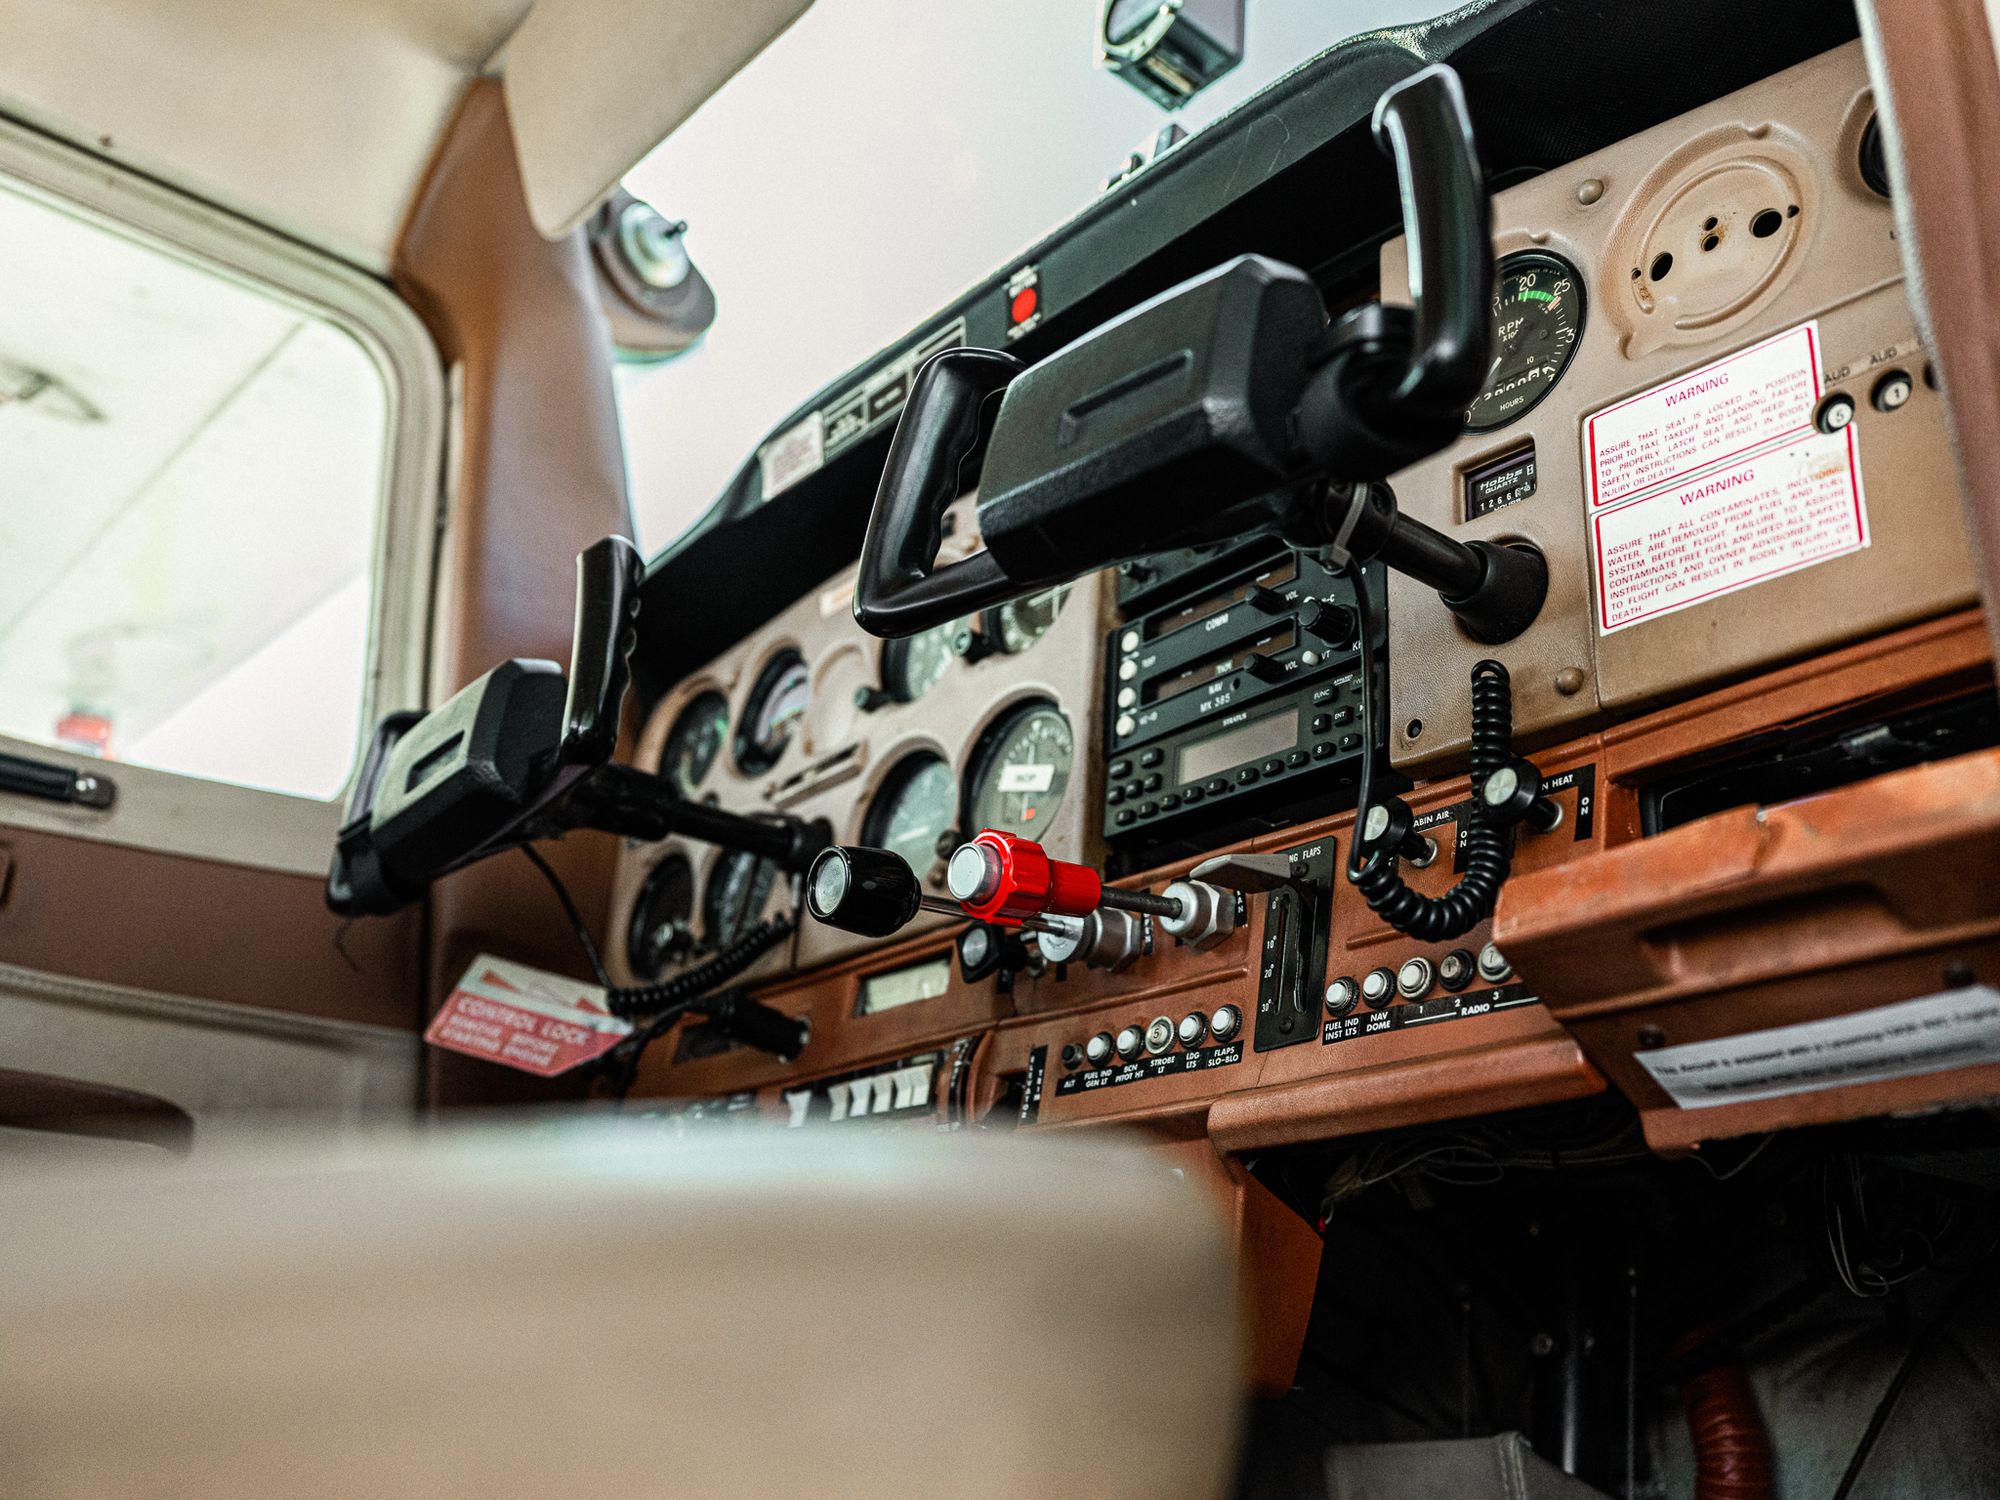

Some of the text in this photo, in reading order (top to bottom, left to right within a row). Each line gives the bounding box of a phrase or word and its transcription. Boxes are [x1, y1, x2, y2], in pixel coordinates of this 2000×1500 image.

[1519, 273, 1536, 292] 20
[1553, 278, 1571, 297] 25
[1498, 317, 1524, 337] RPM
[1870, 346, 1897, 365] AUD
[1824, 366, 1851, 384] AUD
[1665, 373, 1729, 407] WARNING
[1893, 388, 1900, 399] 1
[1500, 396, 1525, 412] HOURS
[1600, 368, 1807, 457] ASSURE THAT SEAT IS LOCKED IN POSITION
[1836, 409, 1845, 422] 5
[1600, 453, 1623, 468] PRIOR
[1626, 447, 1637, 457] TO
[1664, 423, 1699, 442] TAKEOFF
[1705, 413, 1724, 425] AND
[1772, 380, 1807, 398] FAILURE
[1601, 392, 1809, 478] TO PROPERLY LATCH SEAT AND HEED ALL
[1601, 472, 1631, 489] SAFETY
[1635, 446, 1697, 475] INSTRUCTIONS
[1702, 439, 1720, 450] CAN
[1725, 422, 1757, 440] RESULT
[1764, 417, 1773, 425] IN
[1778, 402, 1810, 419] BODILY
[1480, 468, 1523, 490] Hobbs
[1485, 476, 1518, 494] QUARTZ
[1601, 483, 1631, 499] INJURY
[1633, 478, 1645, 487] OR
[1680, 469, 1754, 505] WARNING
[1647, 540, 1665, 552] ARE
[1672, 521, 1718, 544] REMOVED
[1724, 508, 1752, 525] FROM
[1759, 499, 1782, 511] FUEL
[1792, 487, 1812, 500] AND
[1820, 478, 1843, 489] FUEL
[1607, 537, 1643, 556] ASSURE
[1648, 527, 1672, 541] THAT
[1678, 519, 1694, 530] ALL
[1609, 559, 1645, 578] SYSTEM
[1651, 545, 1686, 563] BEFORE
[1736, 512, 1776, 532] FAILURE
[1784, 505, 1798, 514] TO
[1805, 488, 1845, 507] ASSURE
[1609, 500, 1847, 589] CONTAMINATE FREE FUEL AND HEED ALL SAFETY
[1610, 570, 1678, 600] INSTRUCTIONS
[1683, 561, 1704, 574] AND
[1709, 546, 1746, 565] OWNER
[1752, 525, 1811, 550] ADVISORIES
[1819, 512, 1849, 526] PRIOR
[1611, 600, 1623, 610] TO
[1628, 588, 1659, 605] FLIGHT
[1665, 579, 1686, 592] CAN
[1690, 565, 1726, 583] RESULT
[1733, 559, 1743, 568] IN
[1749, 545, 1784, 563] BODILY
[1792, 531, 1828, 548] INJURY
[1835, 523, 1850, 533] OR
[1285, 590, 1298, 601] VOL
[1205, 613, 1229, 631] COMM
[1284, 660, 1298, 671] VOL
[1208, 682, 1223, 695] NAV
[1313, 688, 1330, 700] FUNC
[1214, 693, 1231, 707] 385
[1334, 711, 1346, 720] ENT
[1343, 737, 1349, 745] 9
[1317, 746, 1322, 754] 8
[1291, 755, 1297, 763] 7
[1266, 763, 1271, 771] 6
[1241, 771, 1246, 779] 5
[1552, 774, 1573, 788] HEAT
[1186, 789, 1192, 797] 3
[1581, 797, 1590, 816] ON
[1413, 810, 1450, 828] ABIN AIR
[1460, 830, 1467, 848] ON
[1289, 846, 1322, 864] NG FLAPS
[1455, 998, 1461, 1008] 2
[1492, 991, 1500, 1001] 3
[1370, 1011, 1389, 1022] NAV
[1419, 1005, 1424, 1014] 1
[1461, 1003, 1490, 1017] RADIO
[457, 996, 588, 1046] CONTROL LOCK
[1325, 1017, 1359, 1032] FUEL IND
[1366, 1020, 1391, 1033] DOME
[1153, 1027, 1161, 1039] 5
[1325, 1027, 1357, 1041] INST LTS
[1186, 1051, 1200, 1061] LDG
[1214, 1046, 1235, 1058] FLAPS
[1150, 1055, 1175, 1067] STROBE
[1186, 1060, 1197, 1069] LTS
[1208, 1054, 1239, 1067] SLO-BLO
[1084, 1068, 1112, 1081] FUEL IND
[1124, 1063, 1138, 1073] BCN
[1157, 1066, 1165, 1075] LT
[1085, 1077, 1108, 1088] GEN LT
[1115, 1070, 1144, 1083] PITOT HT
[1021, 1056, 1035, 1119] ELEVATOR
[1033, 1069, 1043, 1101] TRIM
[1063, 1079, 1076, 1089] ALT
